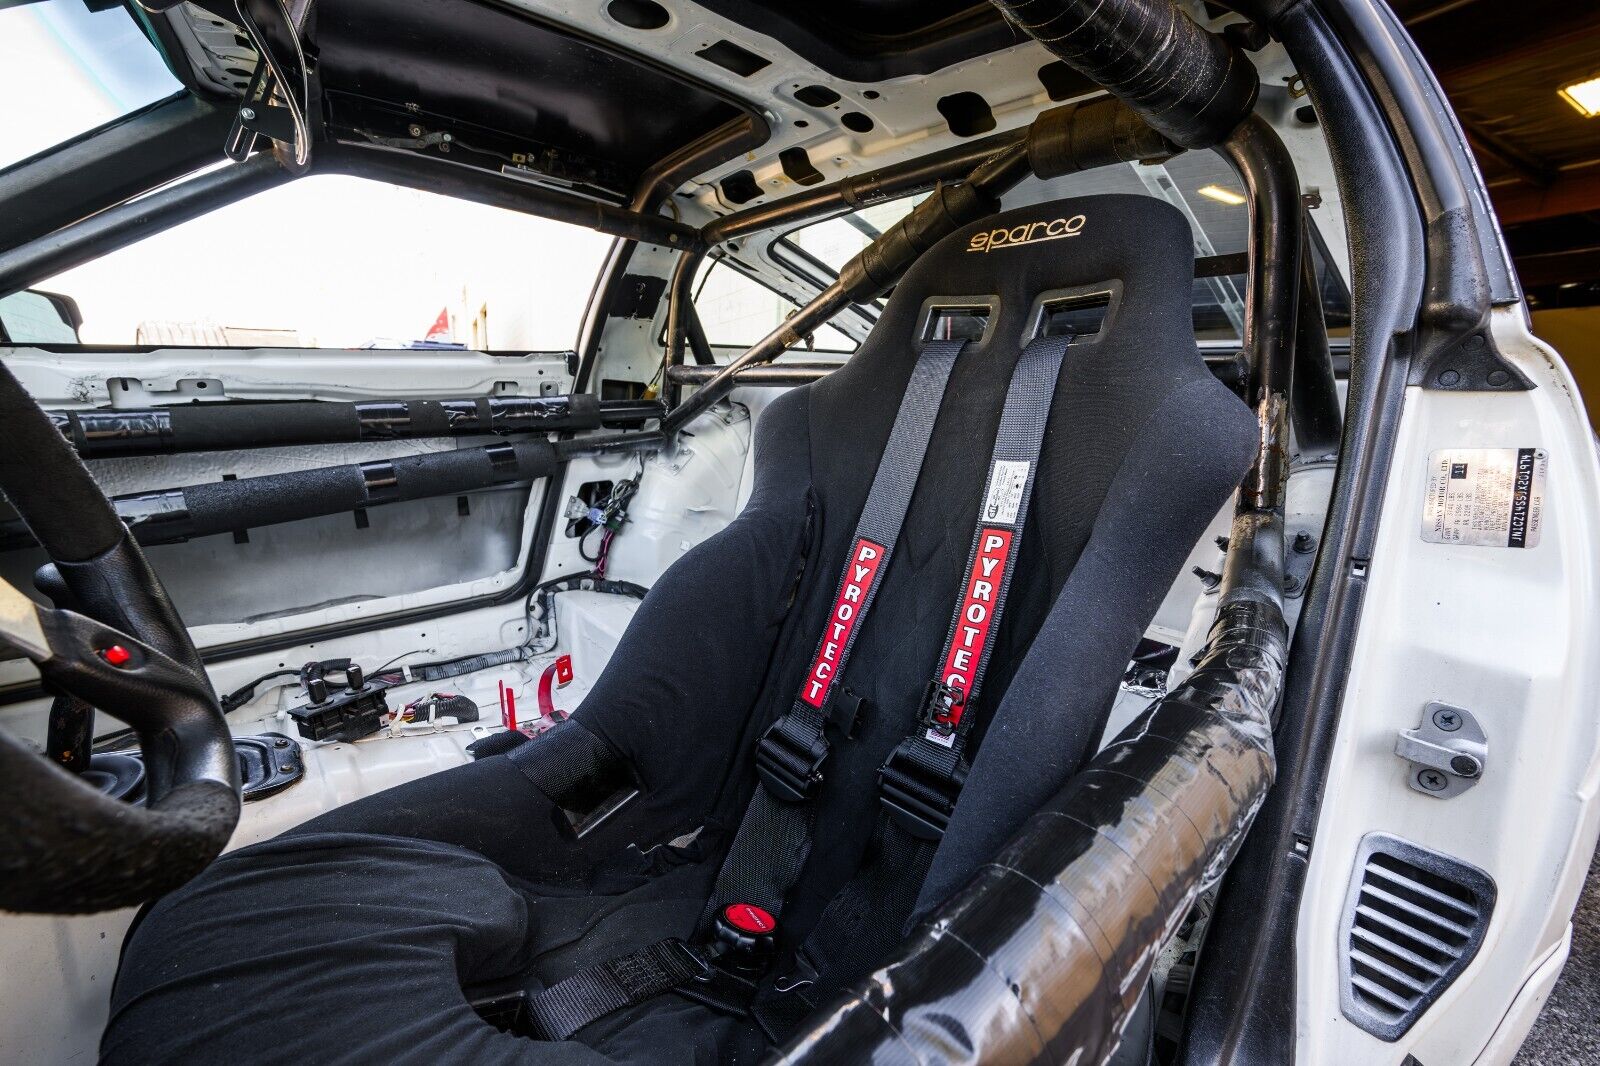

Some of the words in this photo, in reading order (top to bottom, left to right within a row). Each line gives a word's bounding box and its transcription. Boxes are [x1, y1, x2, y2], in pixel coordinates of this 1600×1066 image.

[970, 215, 1086, 252] sparco
[1454, 464, 1464, 474] 11
[1530, 507, 1540, 532] PASSENGER
[810, 546, 876, 699] PYROTECT
